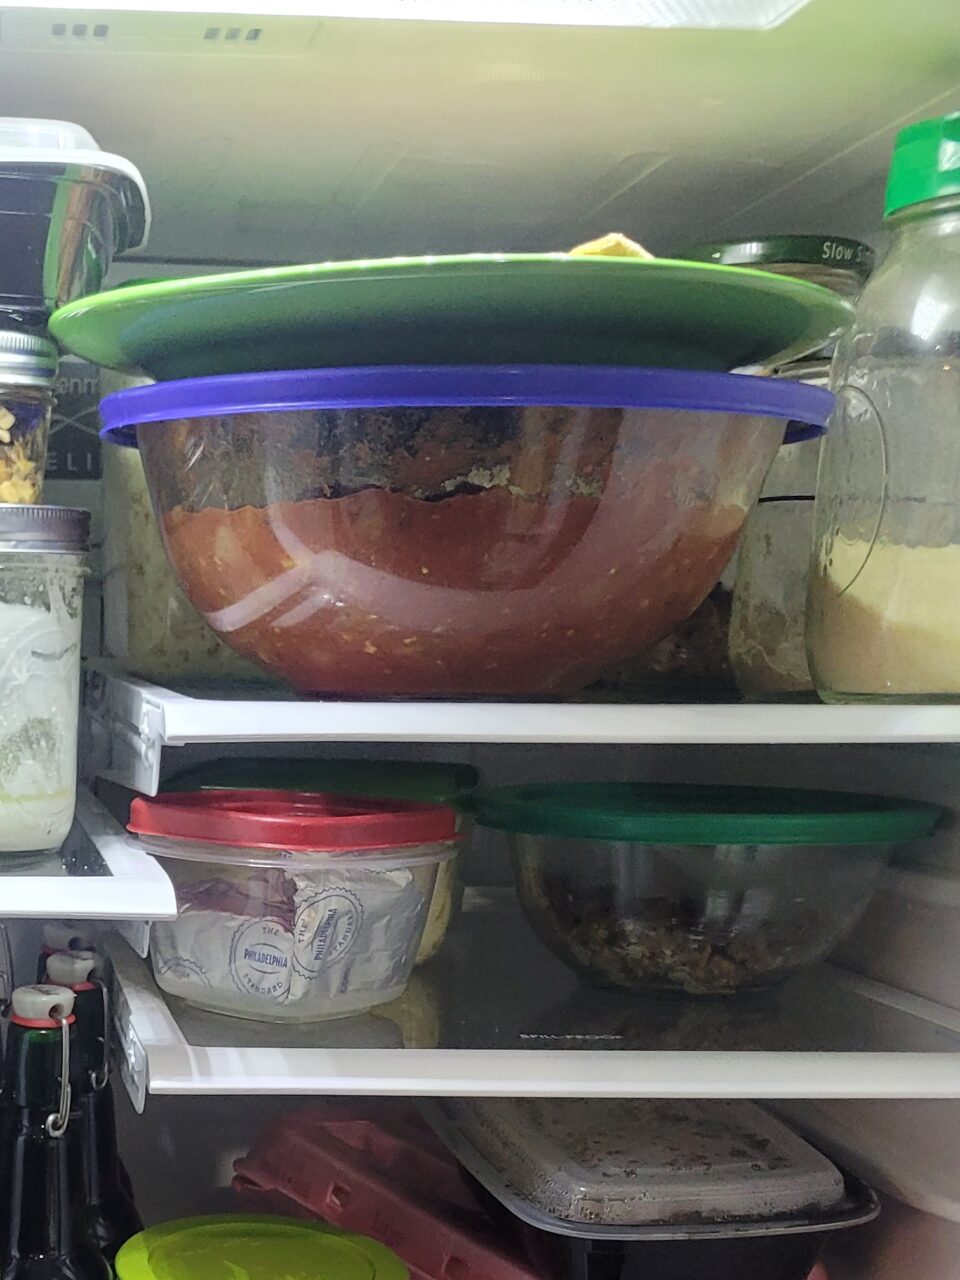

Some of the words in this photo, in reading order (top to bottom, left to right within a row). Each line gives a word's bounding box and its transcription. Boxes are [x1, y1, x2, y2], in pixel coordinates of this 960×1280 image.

[822, 241, 853, 259] Slow
[313, 908, 338, 961] PHILADELPHIA
[243, 947, 288, 969] PHILADELPHIA
